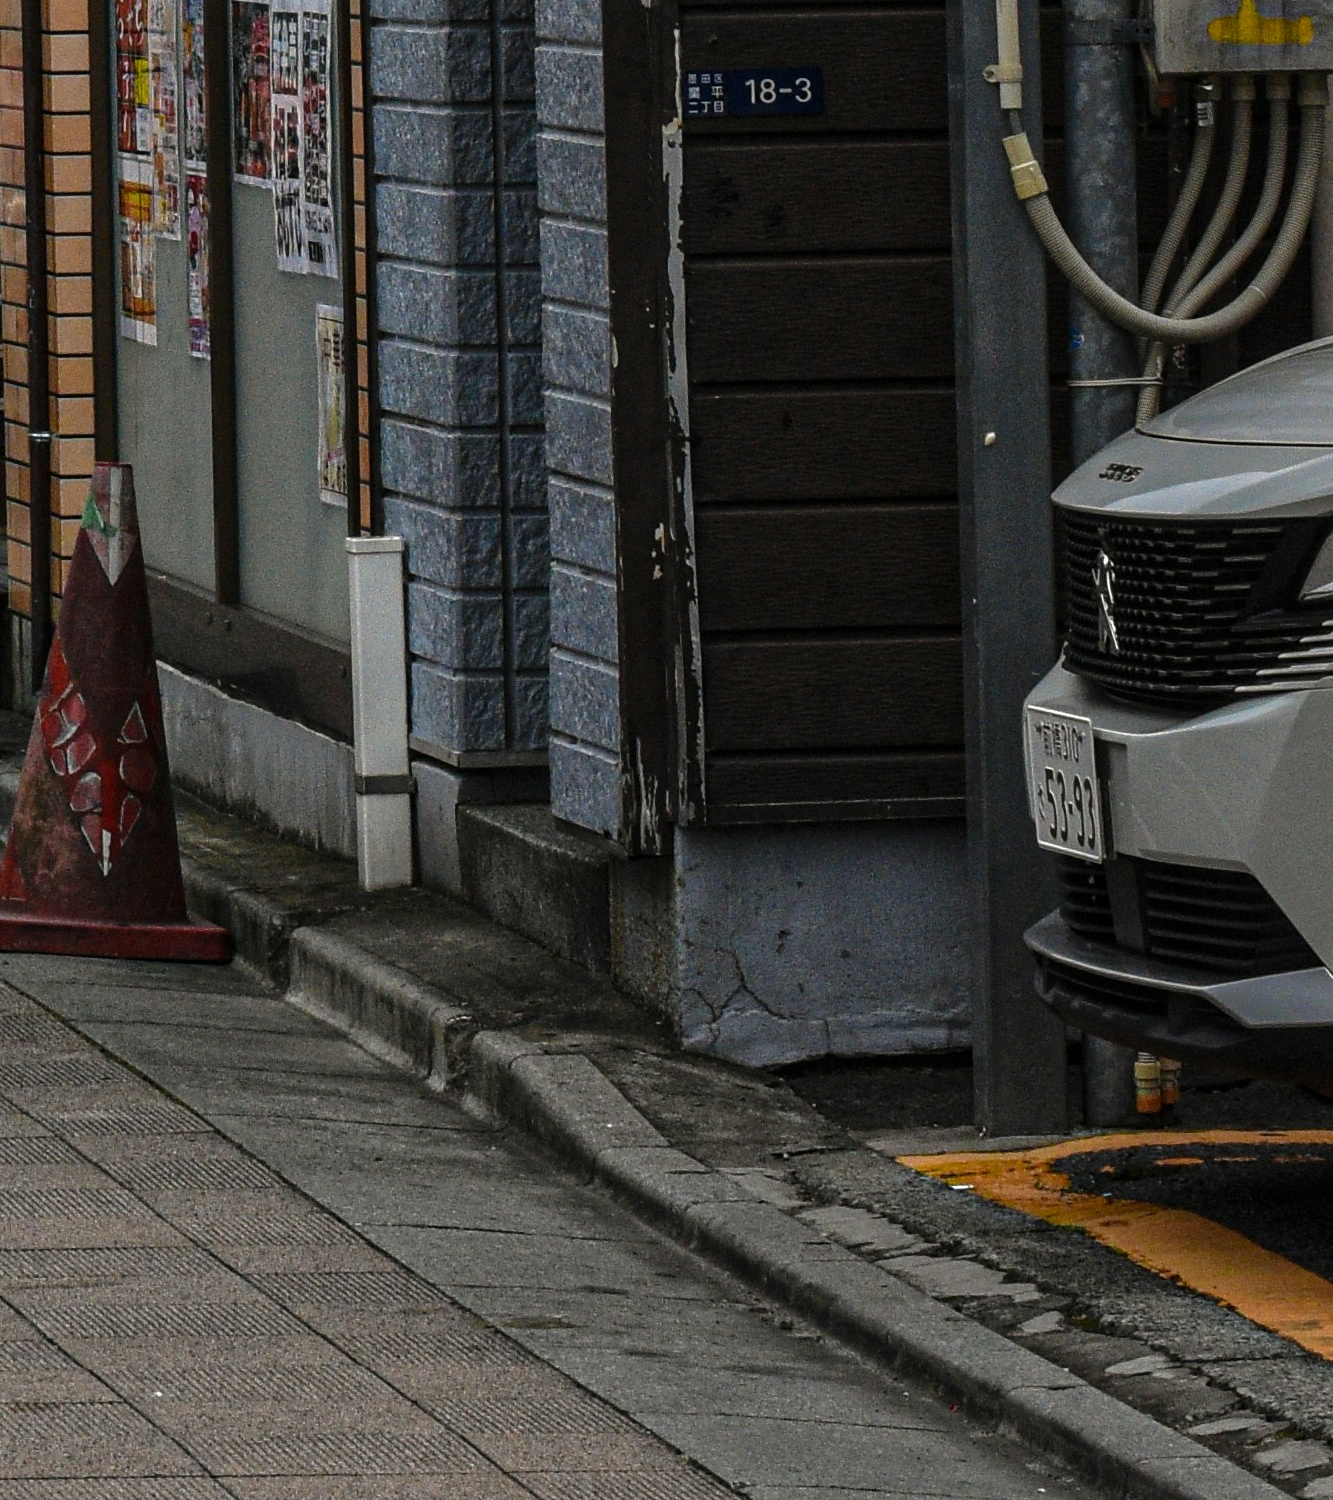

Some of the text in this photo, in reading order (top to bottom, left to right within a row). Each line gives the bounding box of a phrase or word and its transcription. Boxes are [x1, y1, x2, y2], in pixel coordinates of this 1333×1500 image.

[744, 76, 813, 106] 18-3
[688, 100, 725, 115] 二丁目
[1044, 765, 1096, 850] 53-93
